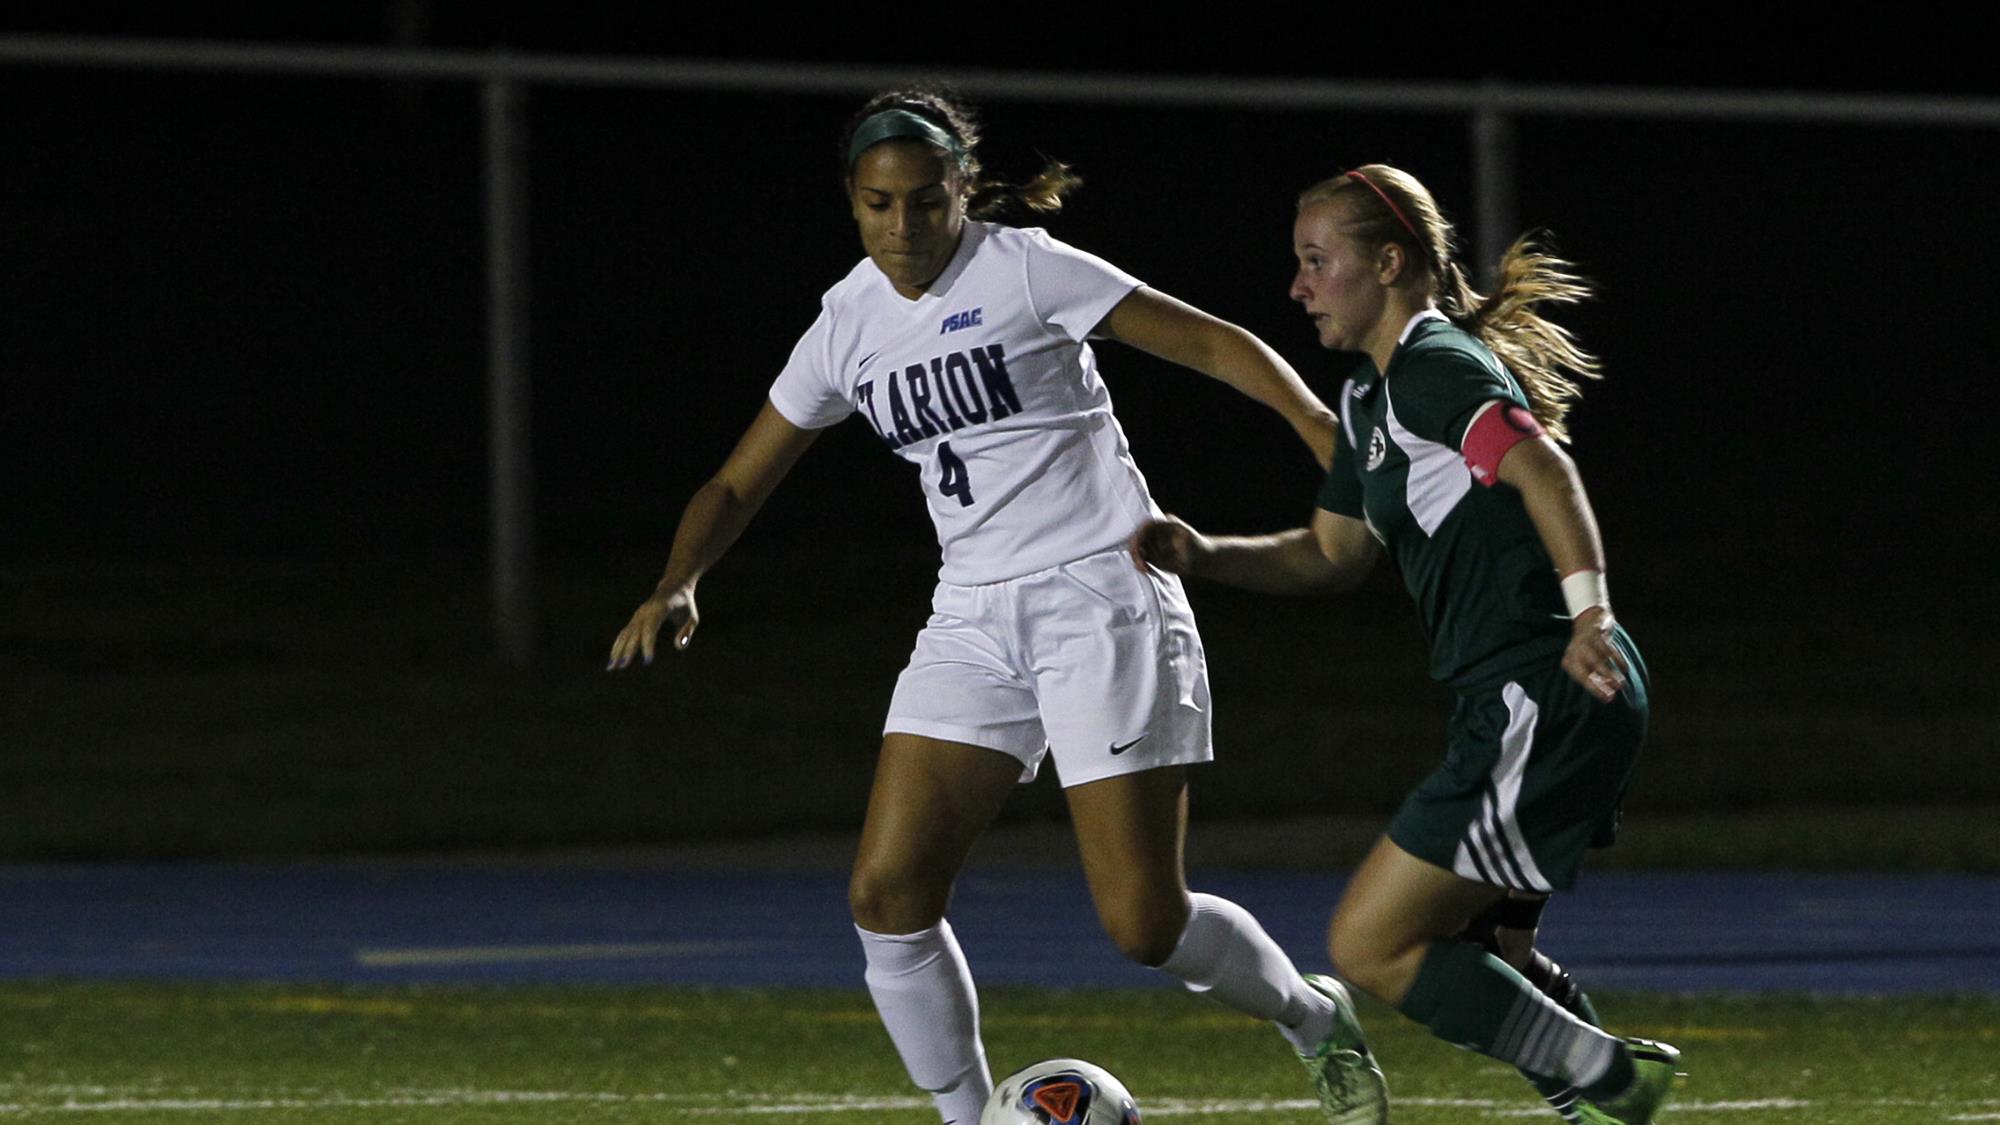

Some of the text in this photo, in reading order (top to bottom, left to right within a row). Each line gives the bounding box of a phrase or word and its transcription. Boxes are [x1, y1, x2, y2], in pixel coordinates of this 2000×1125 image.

[940, 307, 982, 335] PSAC
[857, 343, 1024, 450] LARION
[938, 441, 975, 507] 4
